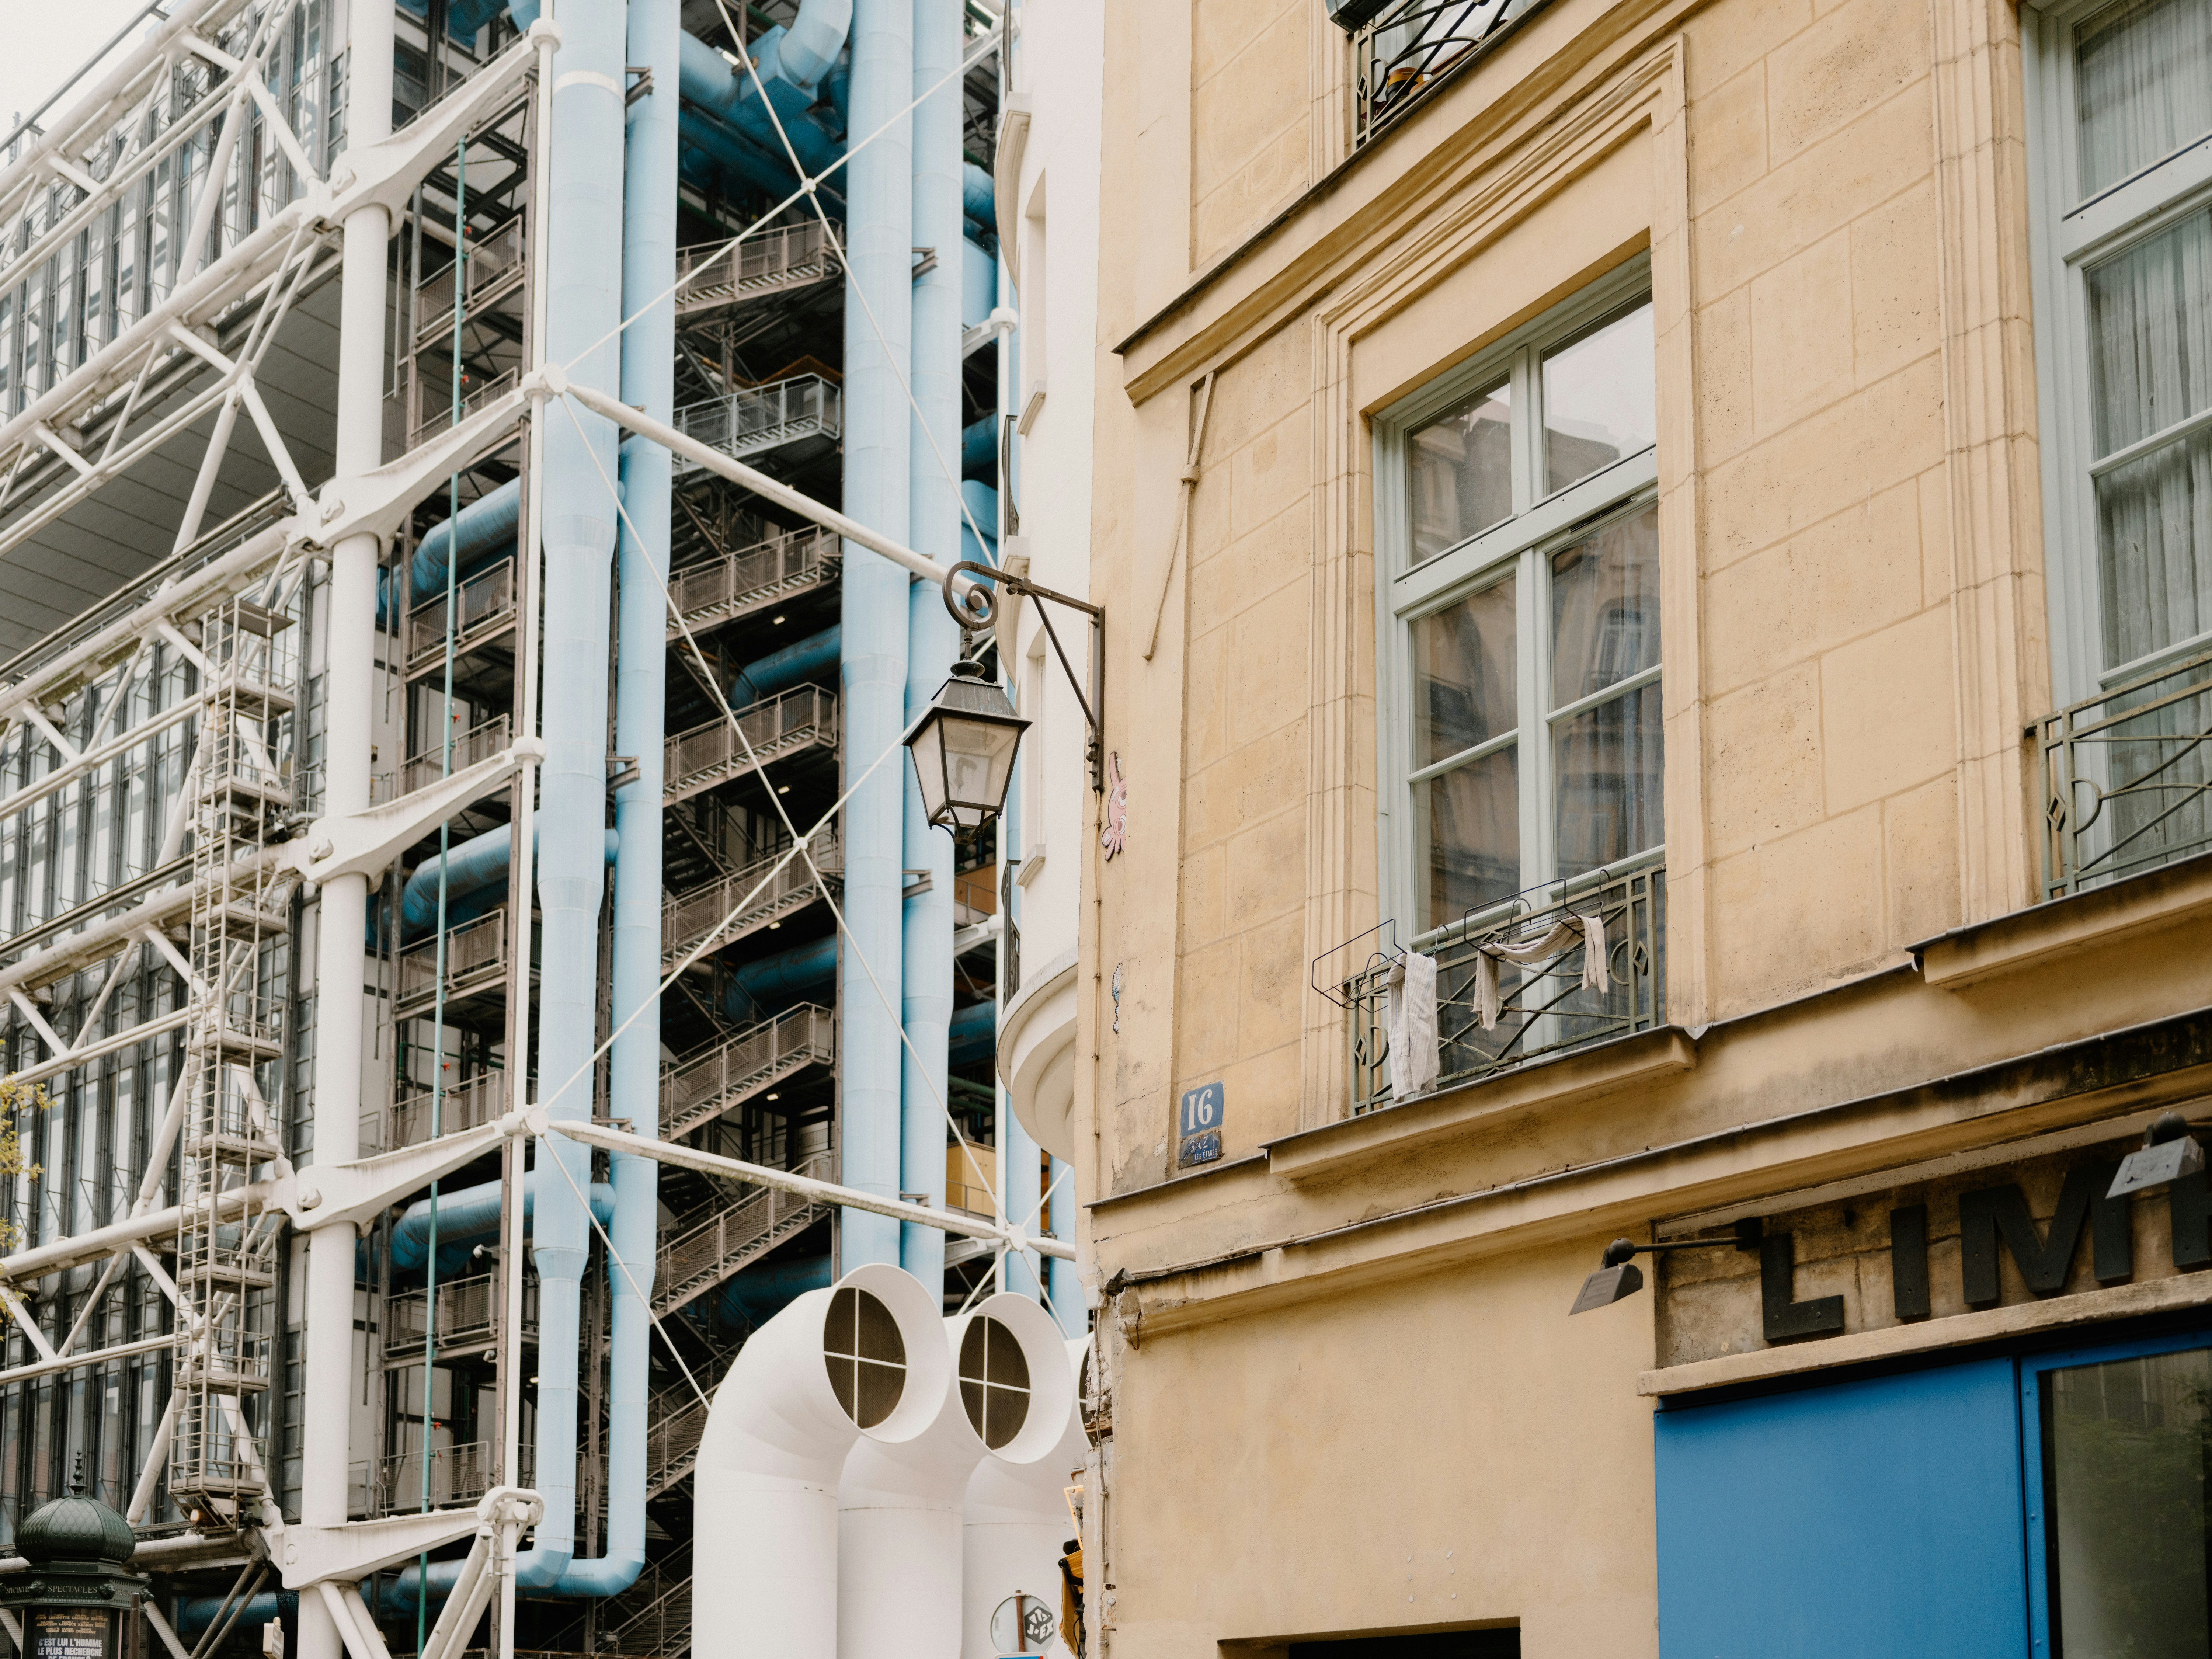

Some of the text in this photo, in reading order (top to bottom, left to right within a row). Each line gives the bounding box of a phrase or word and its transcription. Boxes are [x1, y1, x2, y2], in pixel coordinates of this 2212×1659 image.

[1188, 1089, 1213, 1130] 16
[1203, 1148, 1217, 1158] ÉTAGES
[6, 1586, 30, 1594] SPECTACLES
[48, 1585, 97, 1593] SPECTACLES
[70, 1638, 102, 1647] L'HOMME
[65, 1648, 102, 1656] RECHERCHÉ
